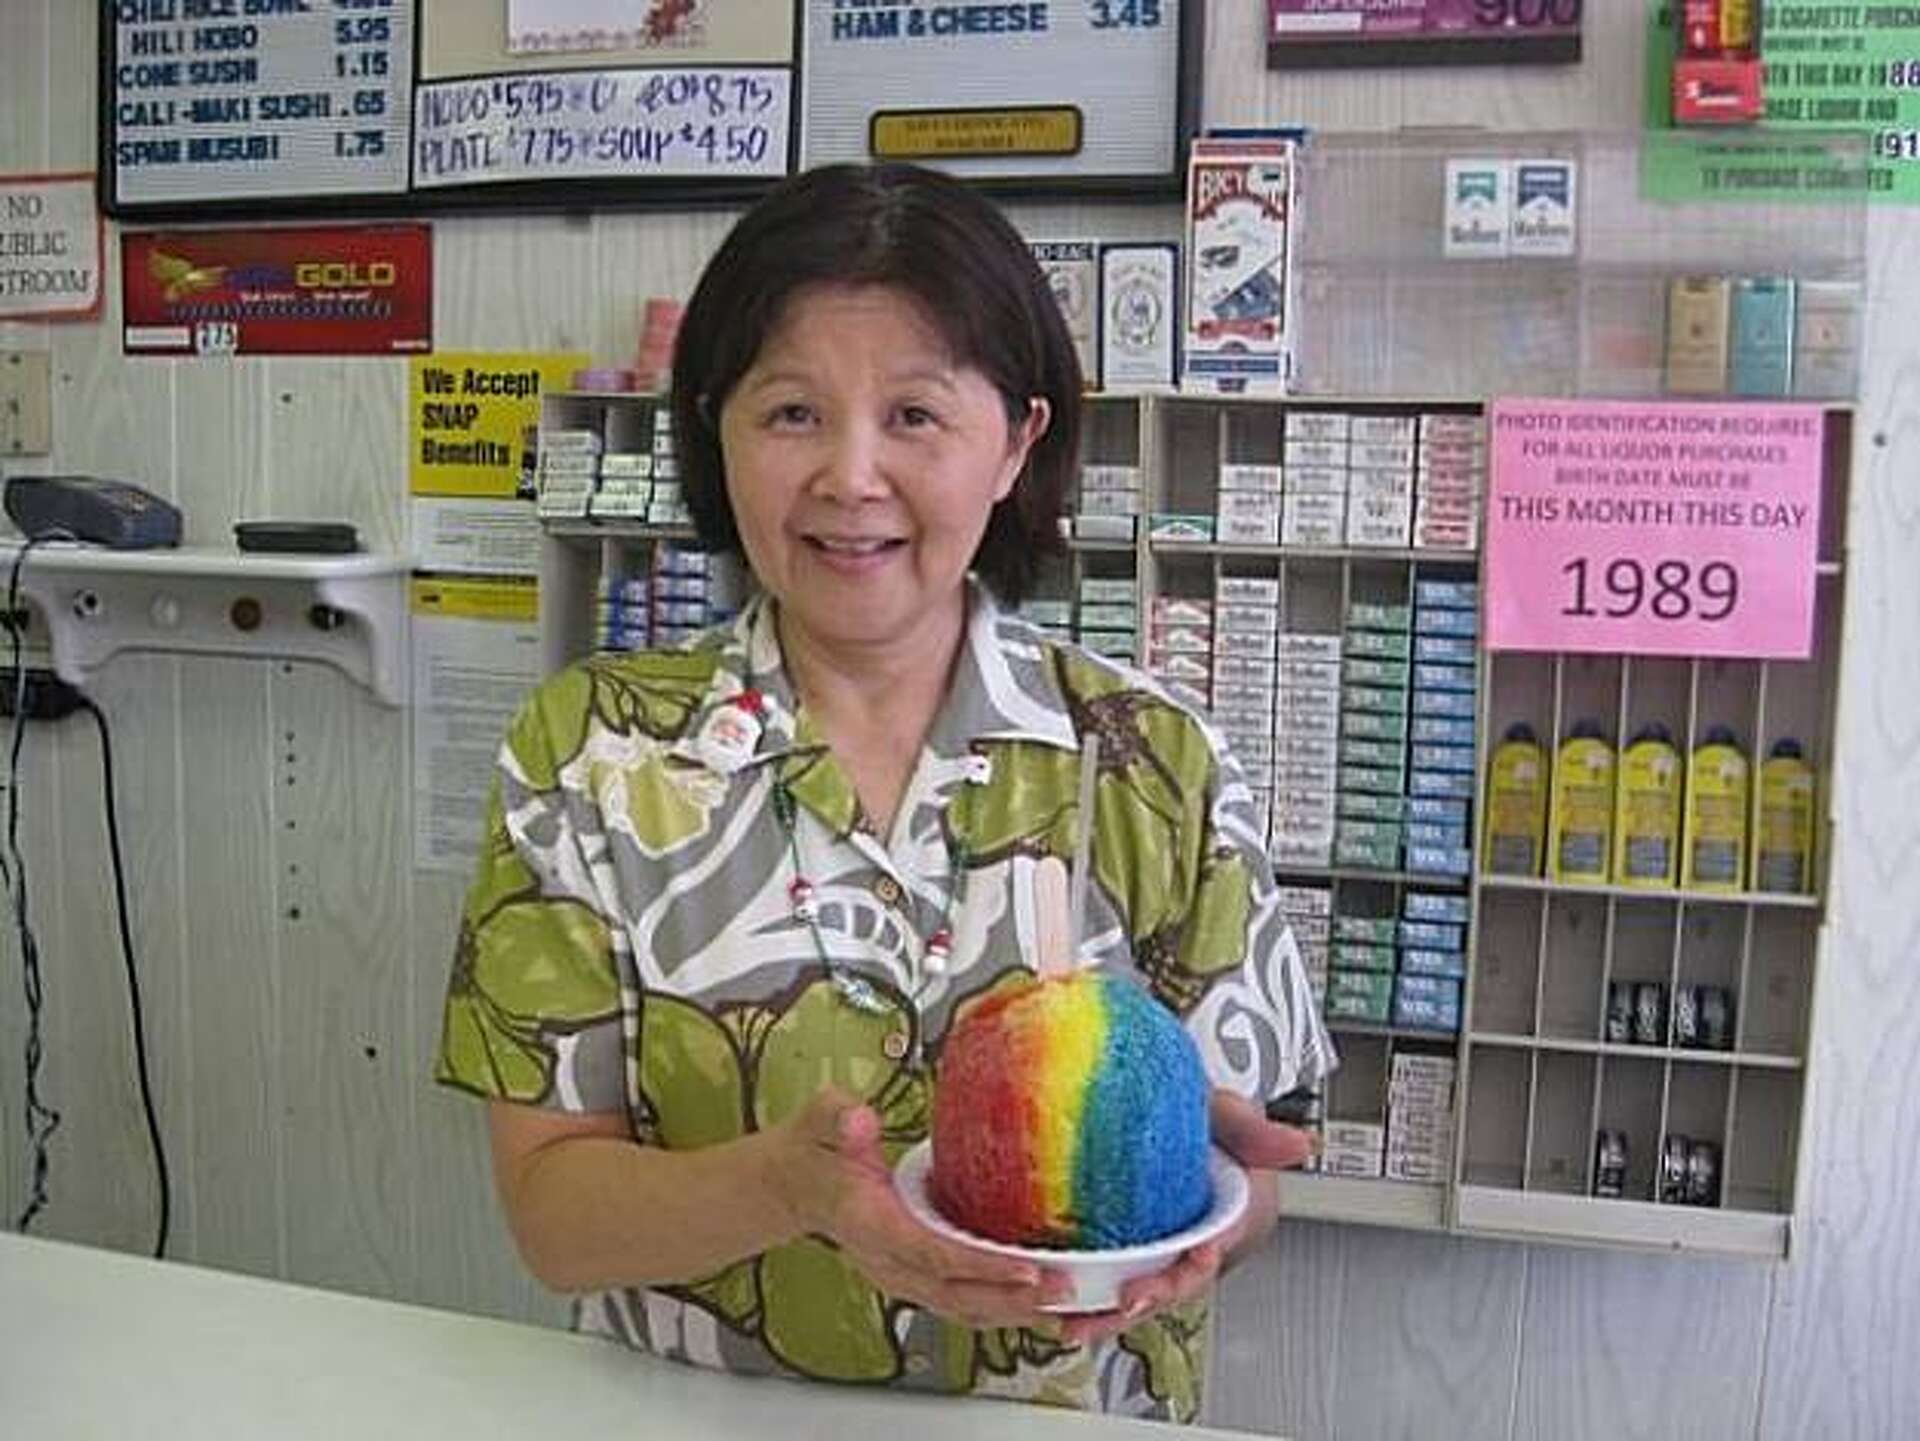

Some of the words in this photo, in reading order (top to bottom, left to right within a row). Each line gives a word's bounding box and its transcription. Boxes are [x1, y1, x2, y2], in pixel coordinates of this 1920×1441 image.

[335, 17, 390, 44] 5.95
[832, 10, 898, 39] HAM
[907, 9, 925, 37] &
[931, 4, 1048, 34] CHEESE
[119, 62, 179, 88] CONE
[188, 58, 258, 83] SUSHI
[336, 52, 388, 77] 1.15
[259, 92, 331, 119] SUSHI
[335, 130, 385, 157] 1.75
[596, 126, 673, 163] SOUP
[8, 196, 42, 219] NO
[296, 263, 395, 287] GOLD
[422, 368, 454, 393] We
[463, 369, 539, 398] Accept
[422, 403, 478, 430] SNAP
[1497, 413, 1561, 432] PHOTO
[1567, 413, 1716, 435] IDENTIFICATION
[421, 438, 510, 467] Benefits
[1523, 440, 1560, 456] FOR
[1565, 442, 1597, 458] ALL
[1603, 442, 1674, 462] LIQUOR
[1678, 444, 1787, 463] PURCHASES
[1555, 466, 1609, 486] BIRTH
[1614, 468, 1662, 488] DATE
[1668, 470, 1723, 489] MUST
[1729, 471, 1750, 489] BE
[1501, 498, 1558, 522] THIS
[1567, 501, 1673, 524] MONTH
[1684, 503, 1743, 527] THIS
[1751, 505, 1806, 529] DAY
[1561, 558, 1739, 621] 1989
